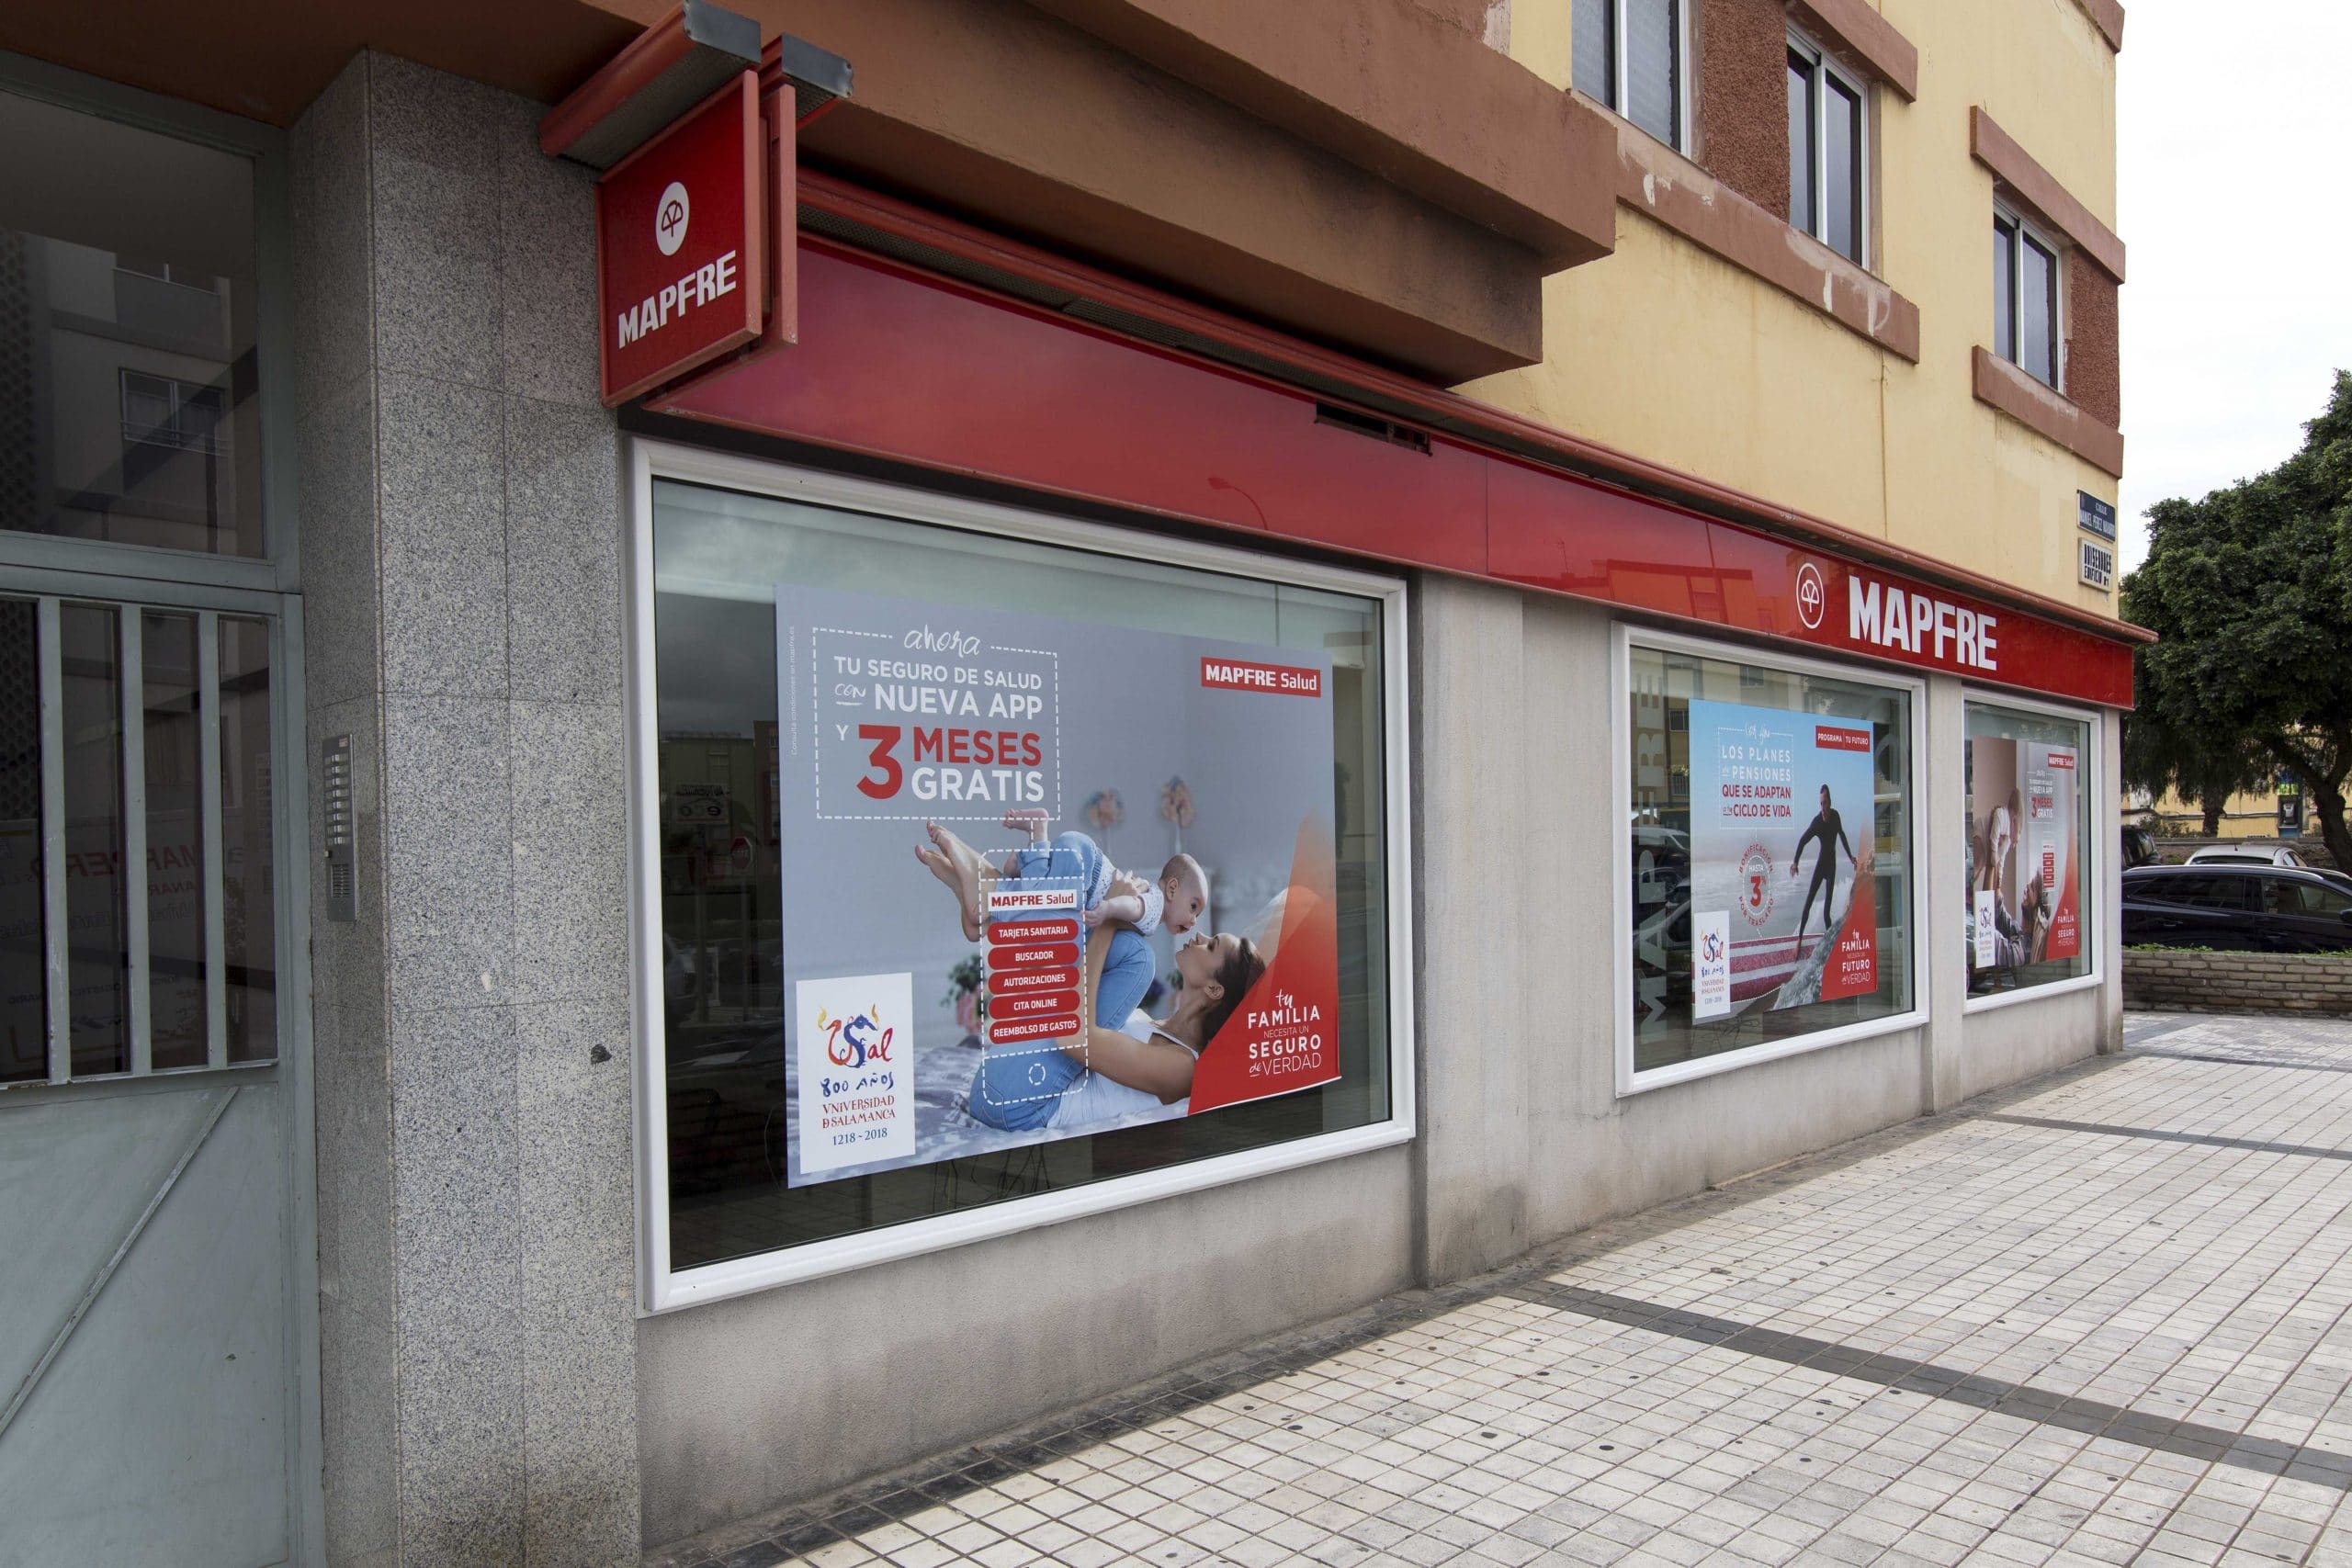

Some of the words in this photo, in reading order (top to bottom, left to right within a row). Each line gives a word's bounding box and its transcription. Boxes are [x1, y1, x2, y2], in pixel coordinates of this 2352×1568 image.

[618, 249, 736, 349] MAPFRE
[1849, 574, 1996, 671] MAPFRE
[904, 624, 980, 658] ahora
[833, 655, 861, 676] TU
[867, 659, 948, 682] SEGURO
[954, 667, 978, 686] DE
[984, 670, 1042, 690] SALUD
[1205, 664, 1276, 687] MAPFRE
[1281, 672, 1317, 691] Salud
[875, 683, 980, 717] NUEVA
[988, 693, 1043, 720] APP
[1817, 732, 1842, 742] PROGRAMA
[1845, 736, 1851, 744] TU
[1852, 736, 1869, 745] FUTURO
[835, 724, 849, 741] Y
[856, 724, 903, 800] 3
[912, 726, 1042, 767] MESES
[1722, 746, 1743, 760] LOS
[1749, 747, 1791, 763] PLANES
[1732, 765, 1791, 781] PENSIONES
[911, 767, 1045, 803] GRATIS
[1722, 784, 1740, 798] QUE
[1742, 784, 1752, 798] SE
[1755, 785, 1792, 799] ADAPTAN
[1733, 803, 1758, 818] CICLO
[1759, 804, 1770, 818] DE
[1772, 805, 1792, 818] VIDA
[991, 894, 1043, 908] MAPFRE
[1046, 892, 1074, 905] Salud
[999, 928, 1029, 939] TARJETA
[1030, 926, 1069, 936] SANITARIA
[1841, 939, 1870, 952] FAMILIA
[1015, 951, 1054, 962] BUSCADOR
[1842, 959, 1871, 972] FUTURO
[1003, 974, 1066, 987] AUTORIZACIONES
[1013, 1001, 1029, 1010] CITA
[1031, 998, 1057, 1010] ONLINE
[1275, 988, 1294, 1009] tu
[1248, 1005, 1320, 1029] FAMILIA
[994, 1024, 1037, 1038] REEMBOLSO
[1039, 1022, 1048, 1032] DE
[1049, 1020, 1077, 1031] GASTOS
[1263, 1027, 1297, 1039] NECESITA
[1298, 1025, 1309, 1033] UN
[1250, 1034, 1321, 1059] SEGURO
[1262, 1052, 1322, 1076] VERDAD
[820, 1077, 849, 1098] 800
[855, 1072, 895, 1090] AÑOS
[831, 1110, 896, 1127] SALAMANCA
[832, 1132, 855, 1145] 1218
[865, 1127, 888, 1141] 2018
